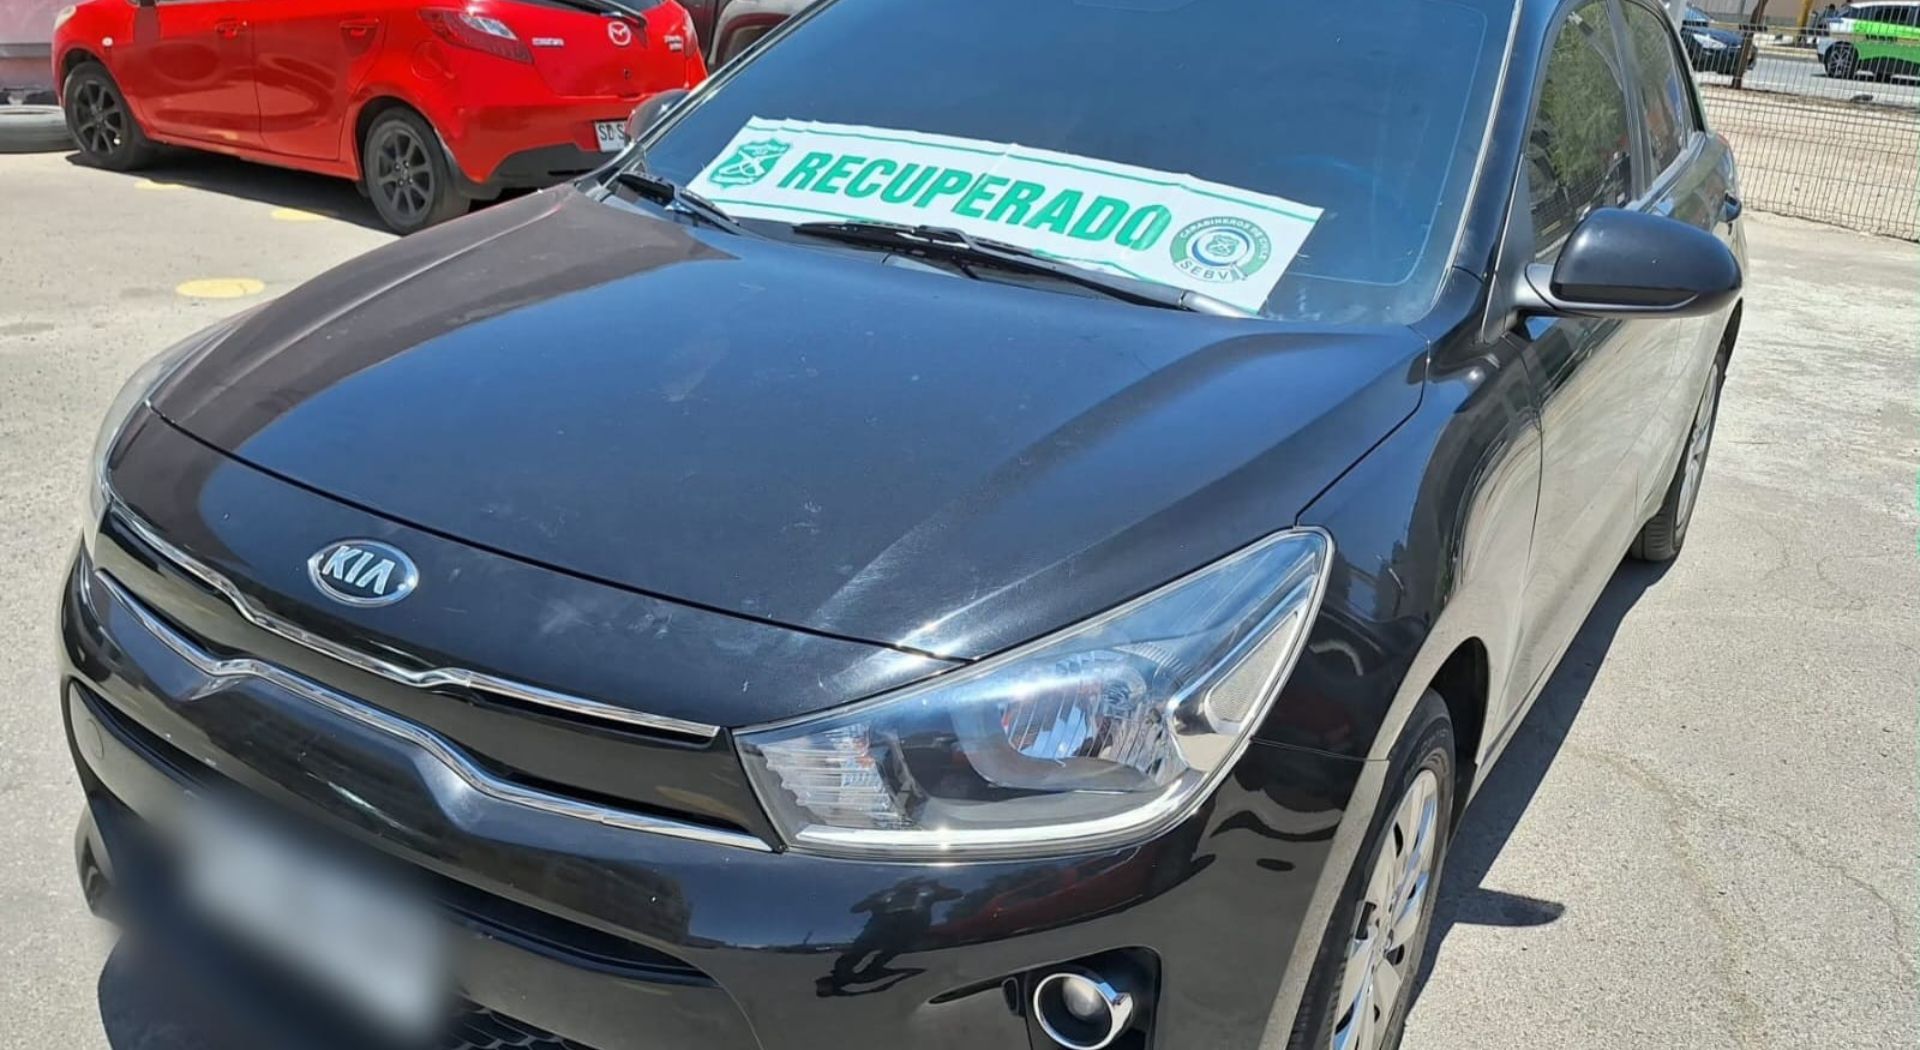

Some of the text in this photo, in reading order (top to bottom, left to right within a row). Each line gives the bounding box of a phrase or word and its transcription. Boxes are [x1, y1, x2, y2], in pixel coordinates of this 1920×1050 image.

[776, 151, 1172, 251] RECUPERADO
[1180, 216, 1250, 238] CARABINEROS
[1180, 261, 1229, 280] SEBV
[321, 545, 396, 595] KIA
